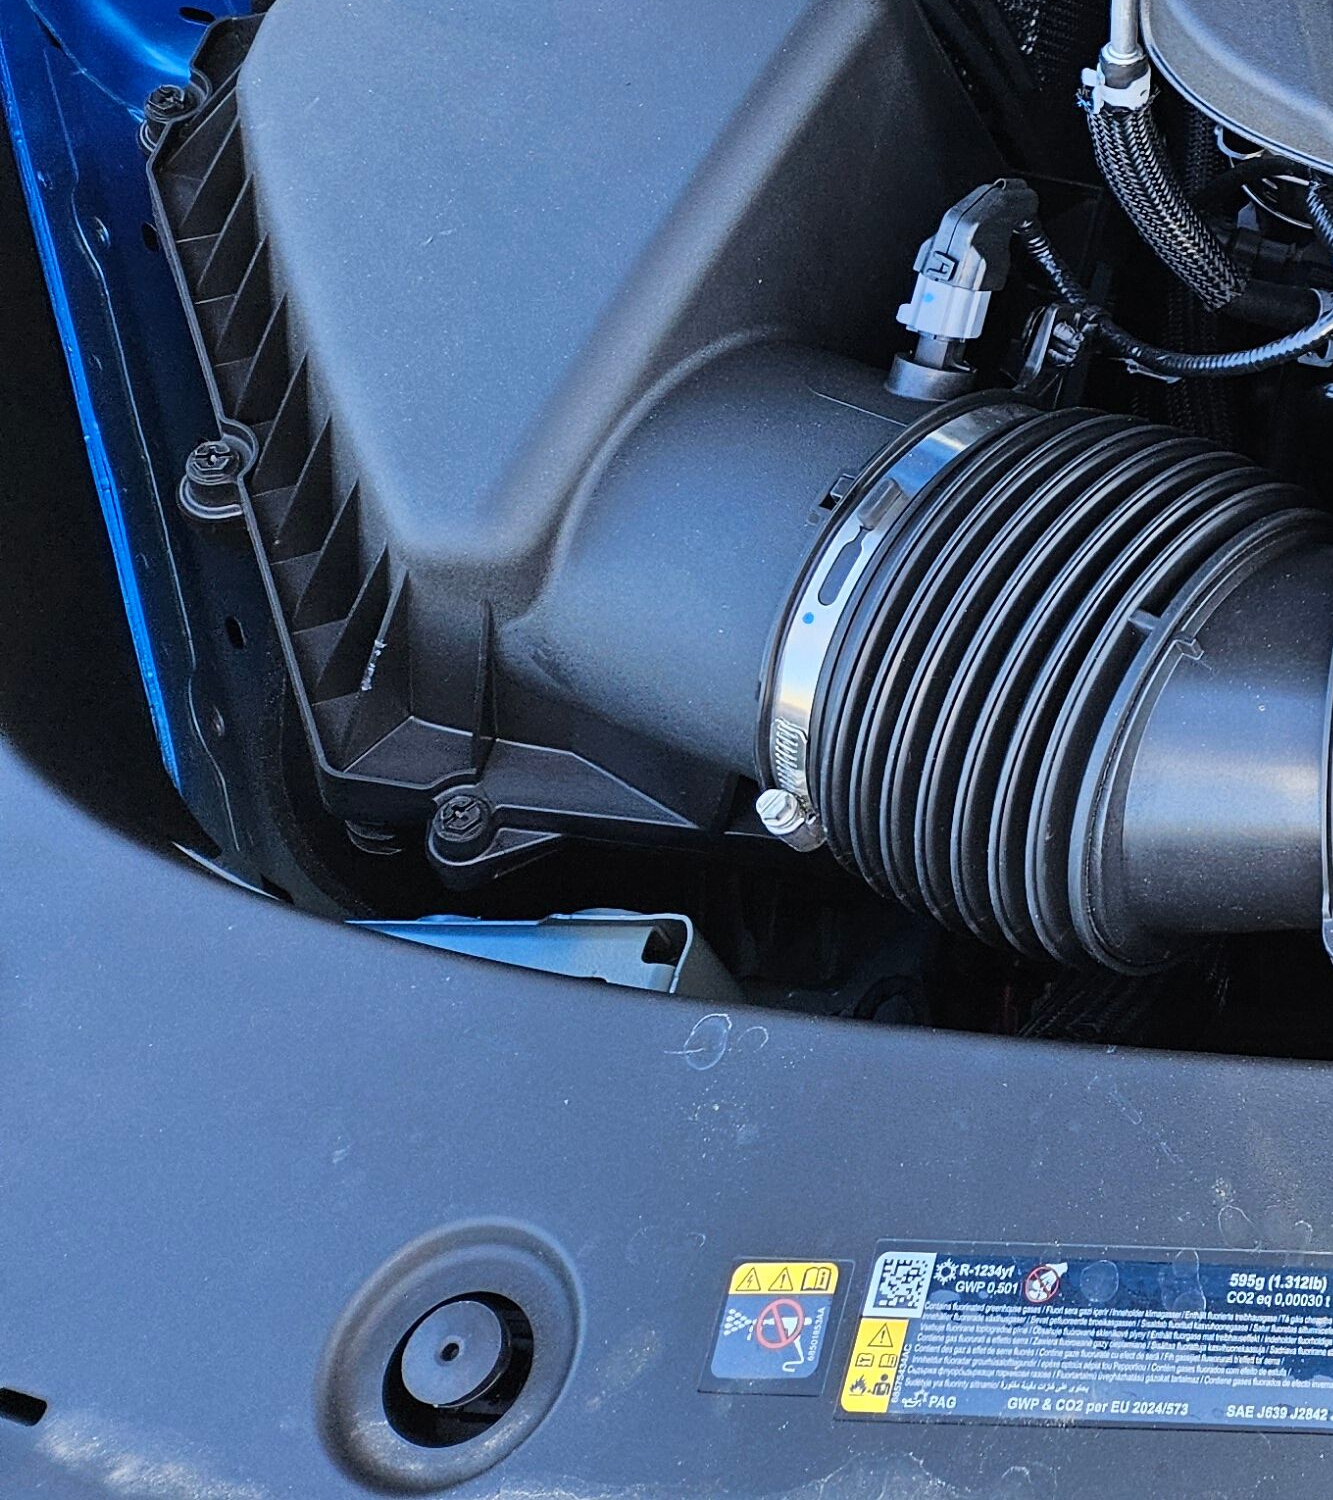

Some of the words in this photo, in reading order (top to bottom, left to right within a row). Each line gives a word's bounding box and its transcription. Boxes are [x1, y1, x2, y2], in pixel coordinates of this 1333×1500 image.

[959, 1263, 1015, 1280] R-1234yf
[955, 1280, 985, 1293] GWP
[987, 1281, 1018, 1295] 0,501
[1228, 1272, 1265, 1290] 595g
[1267, 1274, 1327, 1293] (1.312lb)
[1226, 1291, 1253, 1304] CO2
[1256, 1295, 1271, 1306] eq
[1274, 1293, 1322, 1308] 0,00030
[927, 1395, 957, 1409] PAG
[1006, 1397, 1039, 1411] GWP
[1041, 1398, 1052, 1411] &
[1054, 1399, 1084, 1412] CO2
[1110, 1400, 1129, 1414] EU
[1131, 1401, 1189, 1415] 2024/573
[1225, 1404, 1255, 1417] SAE
[1256, 1405, 1288, 1419] J639
[1289, 1406, 1328, 1420] J2842
